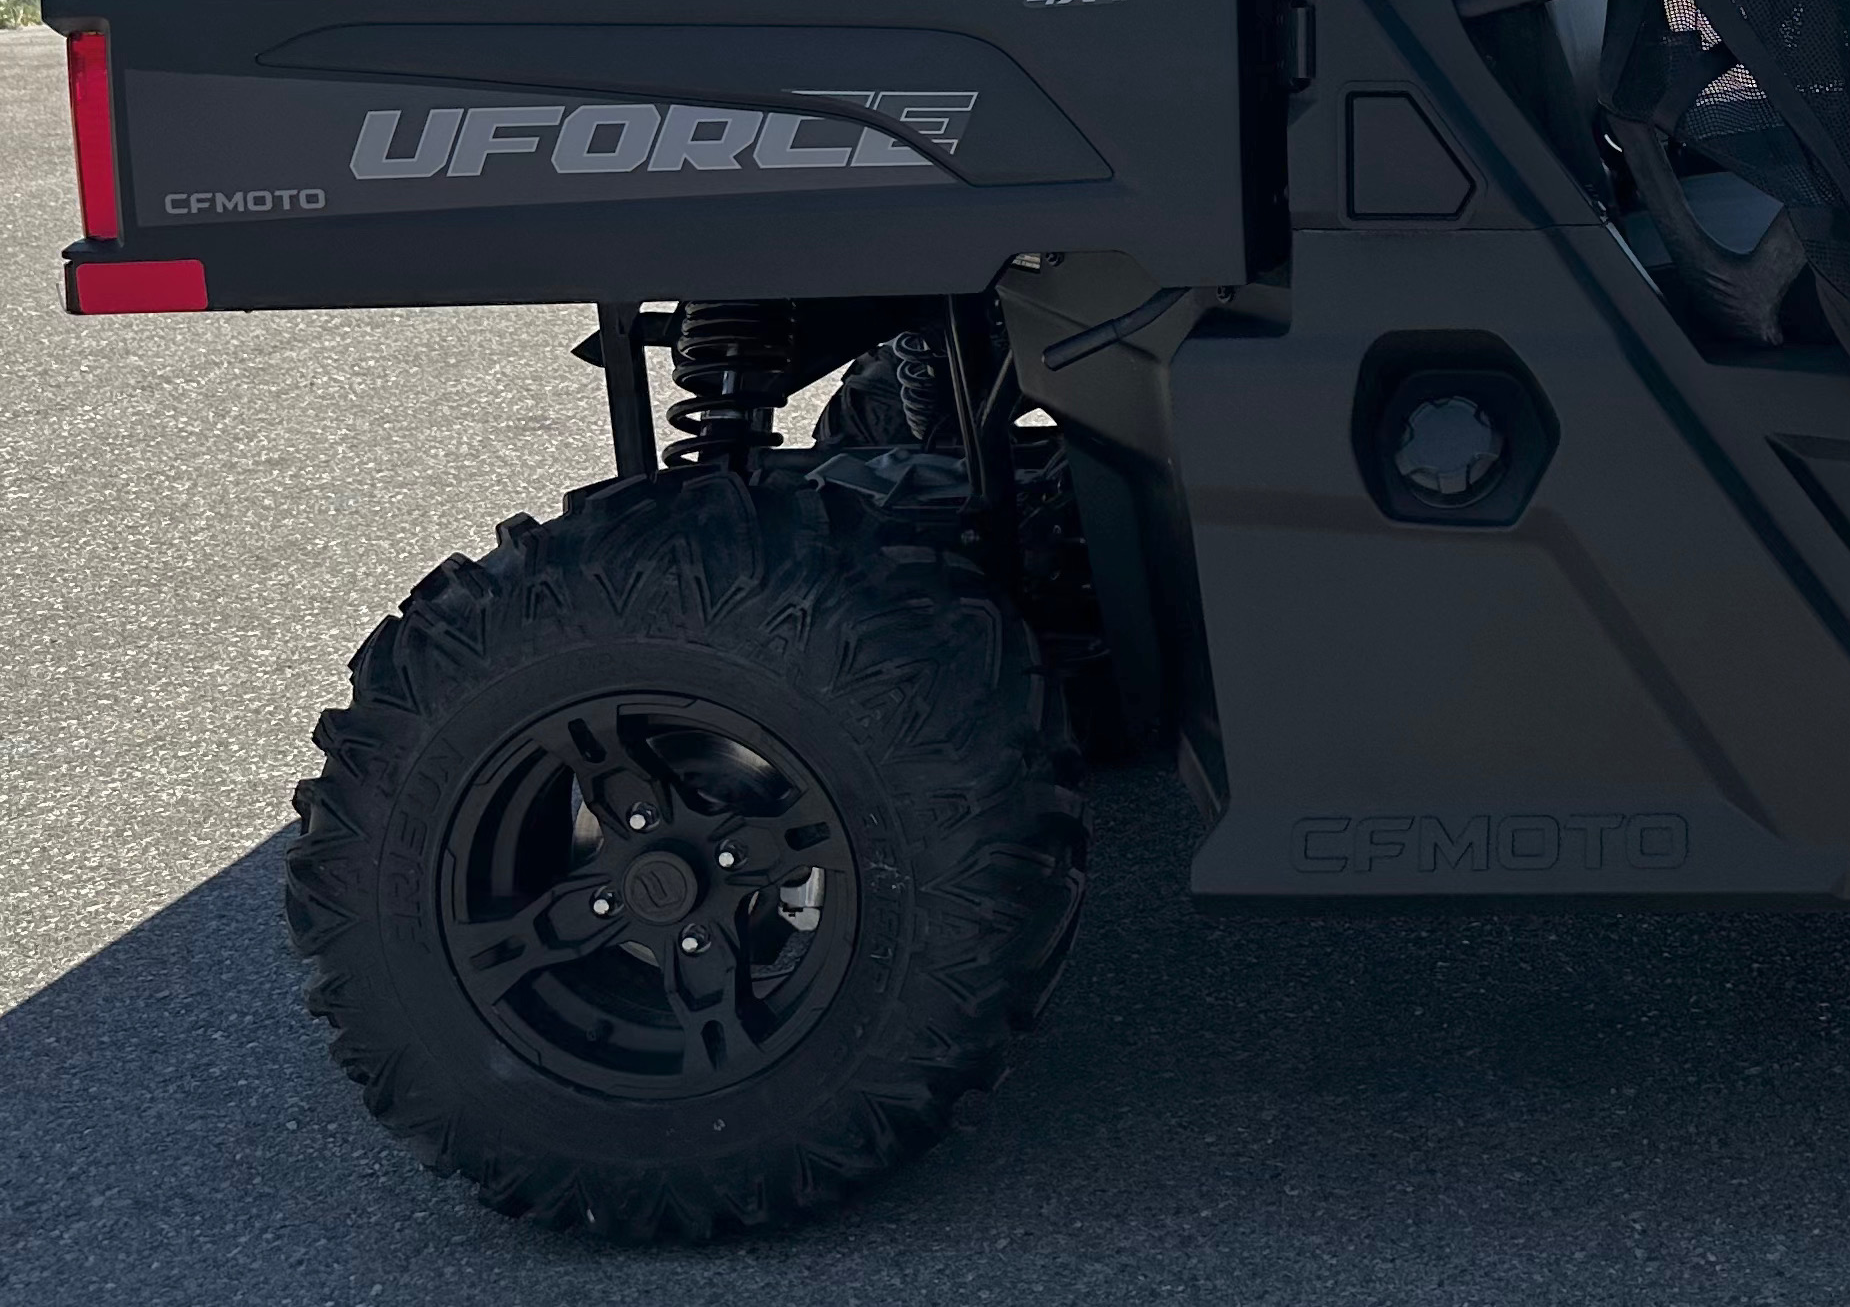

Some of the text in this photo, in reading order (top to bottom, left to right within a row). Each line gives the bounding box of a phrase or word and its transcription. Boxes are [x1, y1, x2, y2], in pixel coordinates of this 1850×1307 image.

[349, 90, 979, 180] UFORCE
[164, 188, 327, 215] CFMOTO
[1289, 812, 1690, 873] CFMOTO
